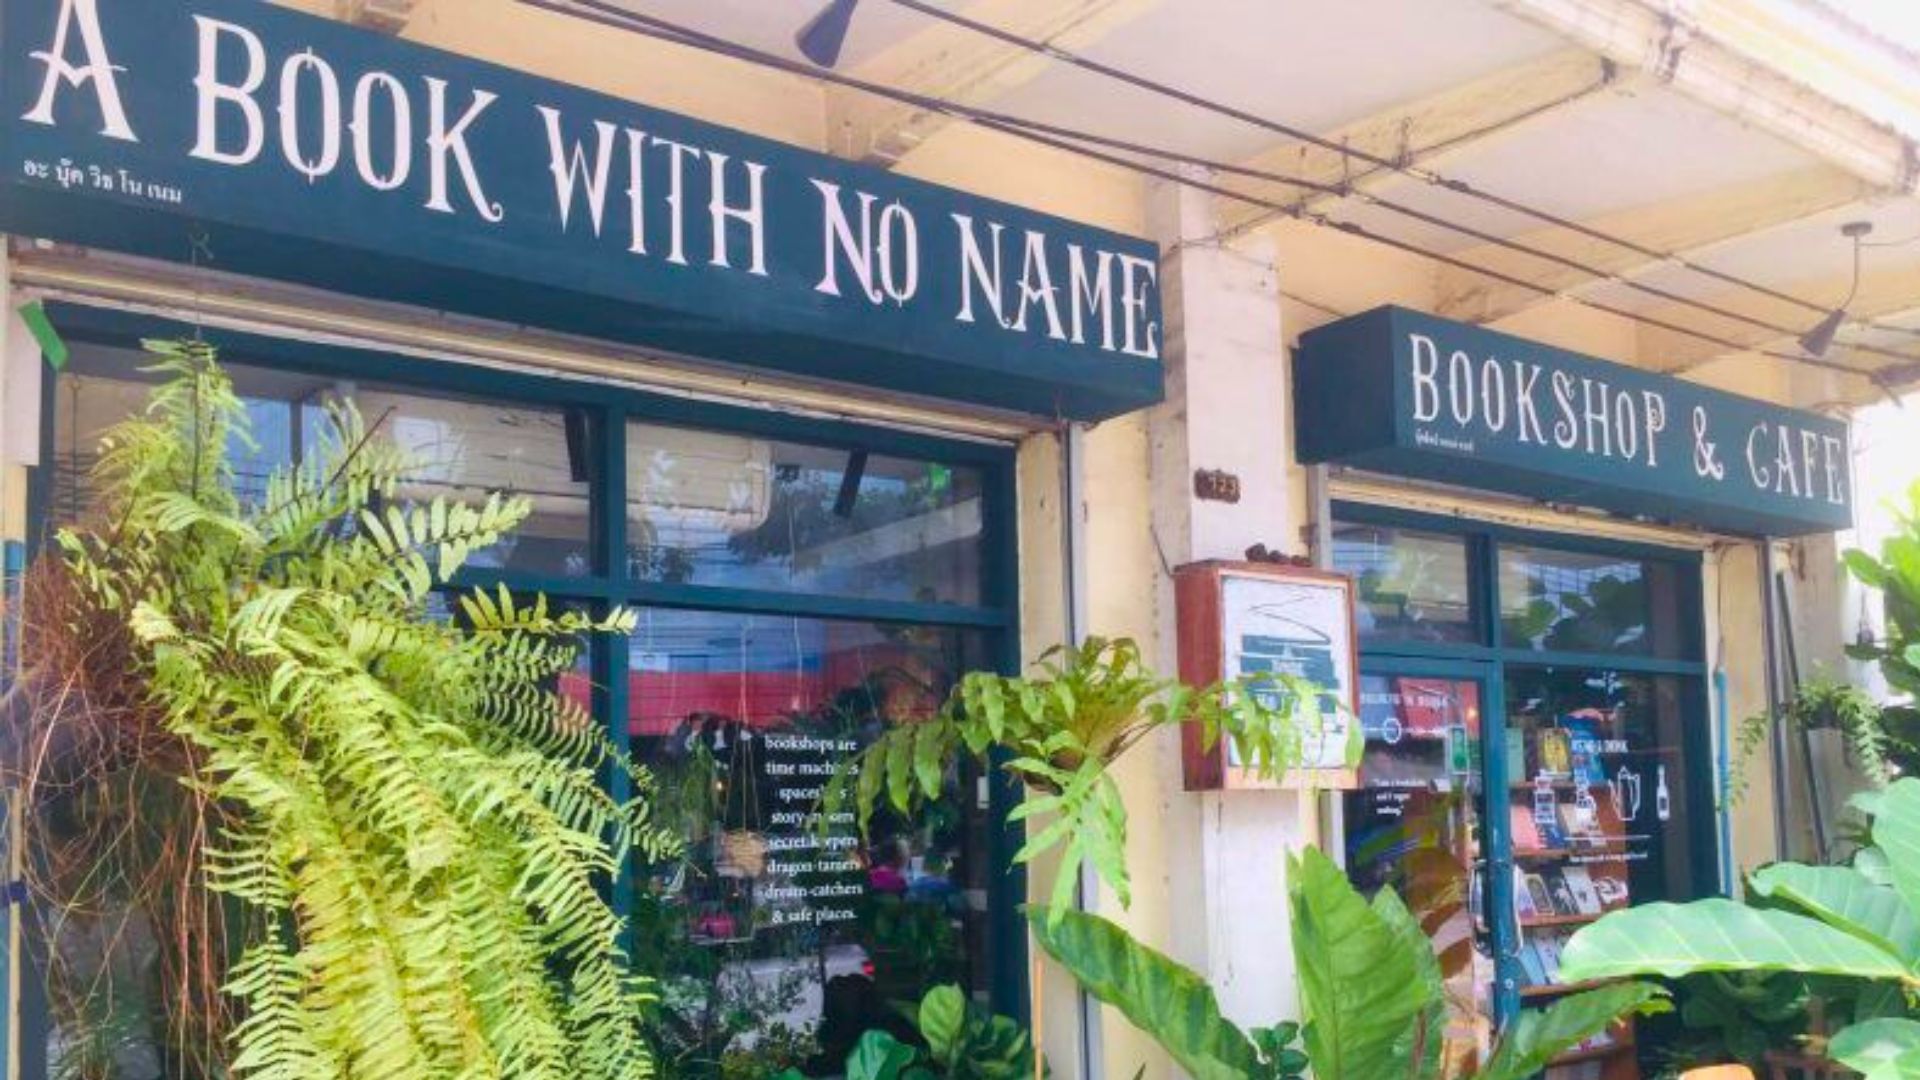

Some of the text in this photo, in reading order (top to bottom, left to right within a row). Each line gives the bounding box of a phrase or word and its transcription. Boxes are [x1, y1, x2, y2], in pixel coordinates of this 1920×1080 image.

[20, 0, 1158, 359] A BOOK WITH NO NAME
[1410, 334, 1844, 505] BOOKSHOP & CAFE
[765, 735, 857, 754] bookshops are
[765, 761, 795, 775] time
[764, 881, 863, 898] dream-catchers
[772, 910, 784, 924] &
[788, 905, 812, 922] safe
